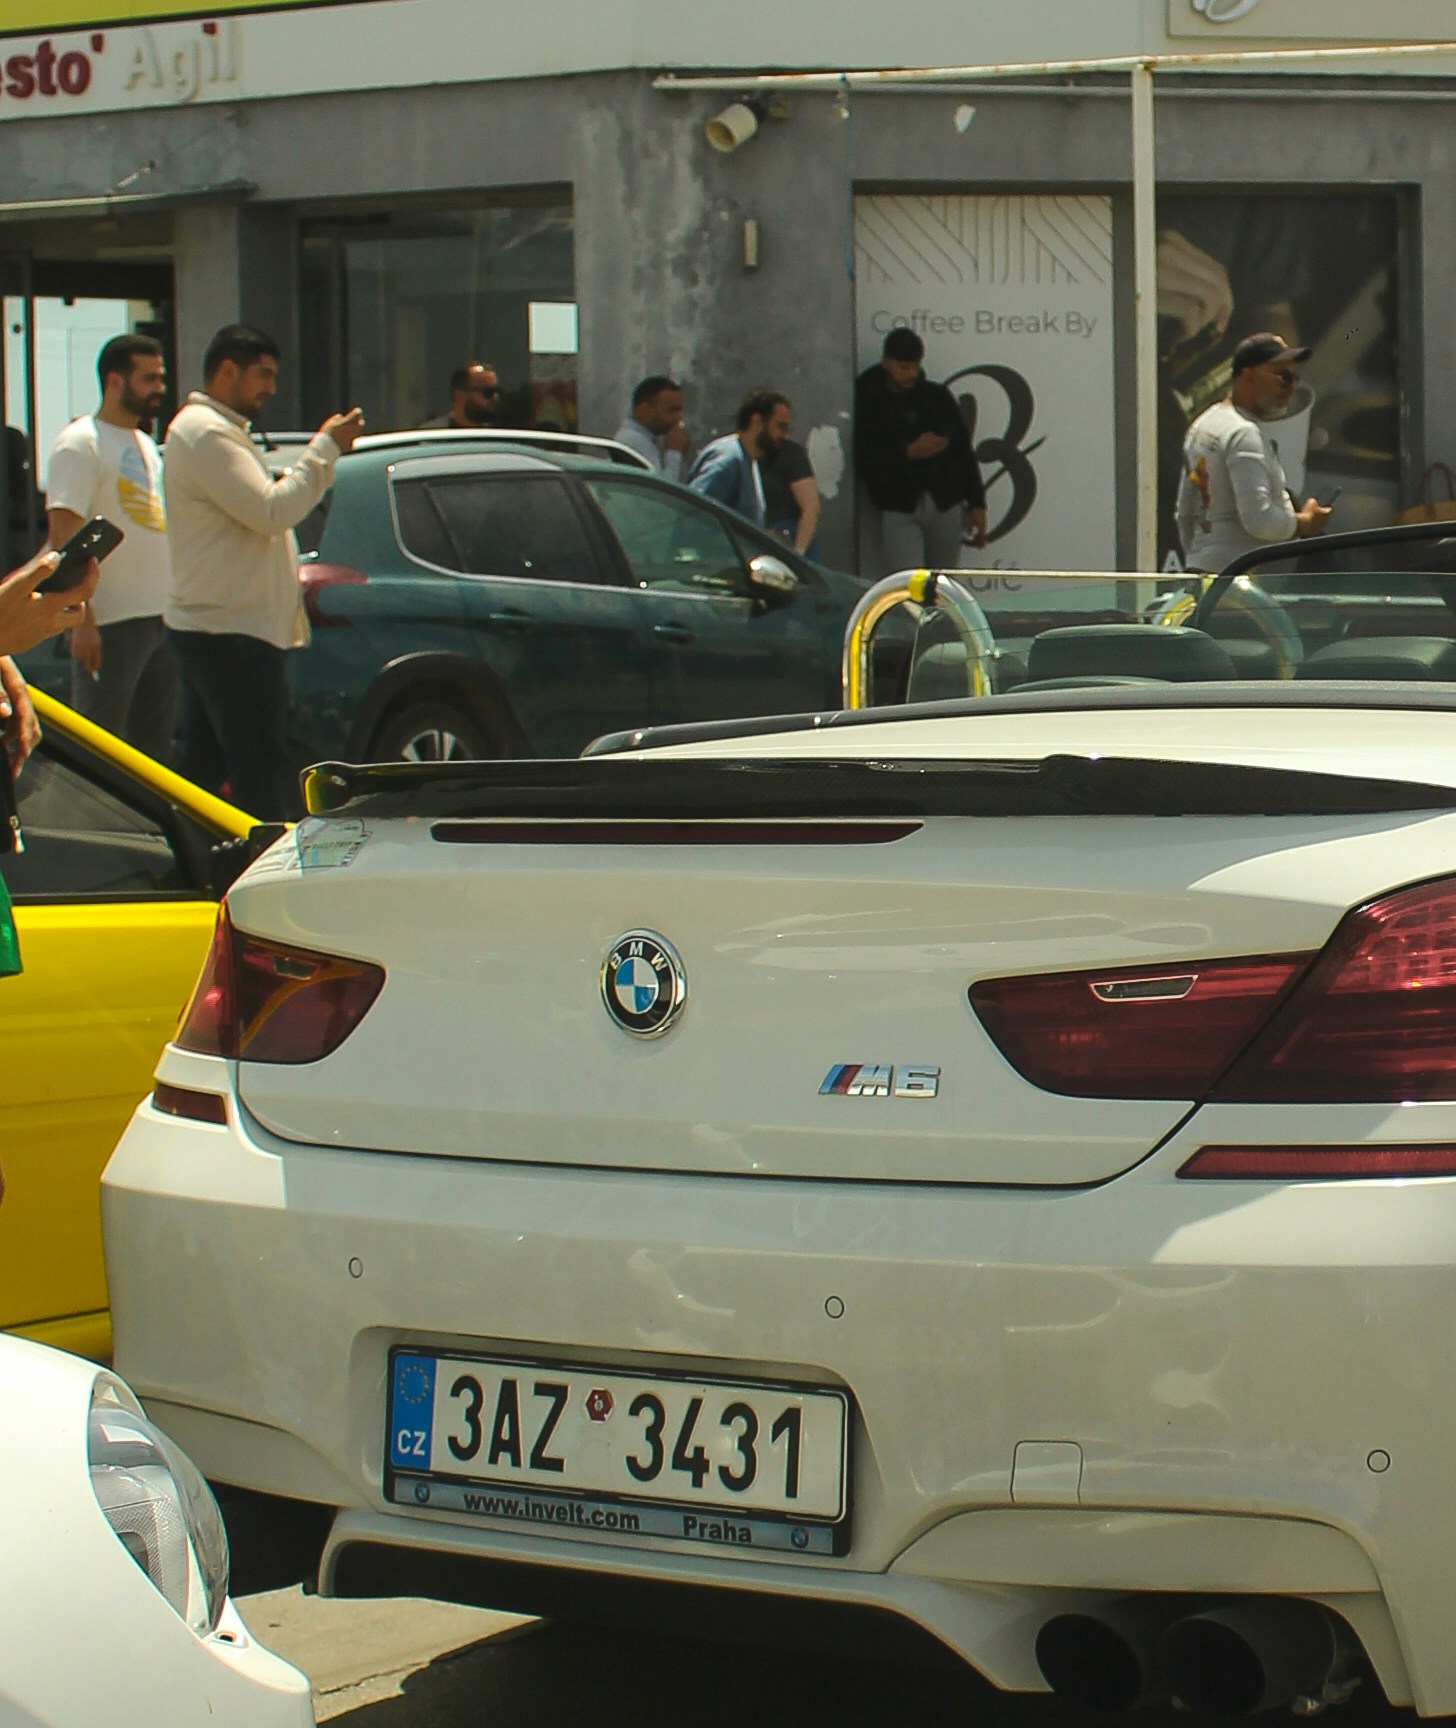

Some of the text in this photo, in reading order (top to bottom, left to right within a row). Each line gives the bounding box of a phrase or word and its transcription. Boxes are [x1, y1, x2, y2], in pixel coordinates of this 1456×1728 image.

[0, 19, 243, 104] sto' Agil
[974, 309, 1059, 334] Break
[1065, 310, 1098, 339] By
[610, 941, 669, 972] BMW
[843, 1063, 941, 1098] M6
[397, 1428, 427, 1457] CZ
[447, 1374, 804, 1500] 3AZ 3431
[463, 1491, 753, 1544] www.invelt.com Praha
